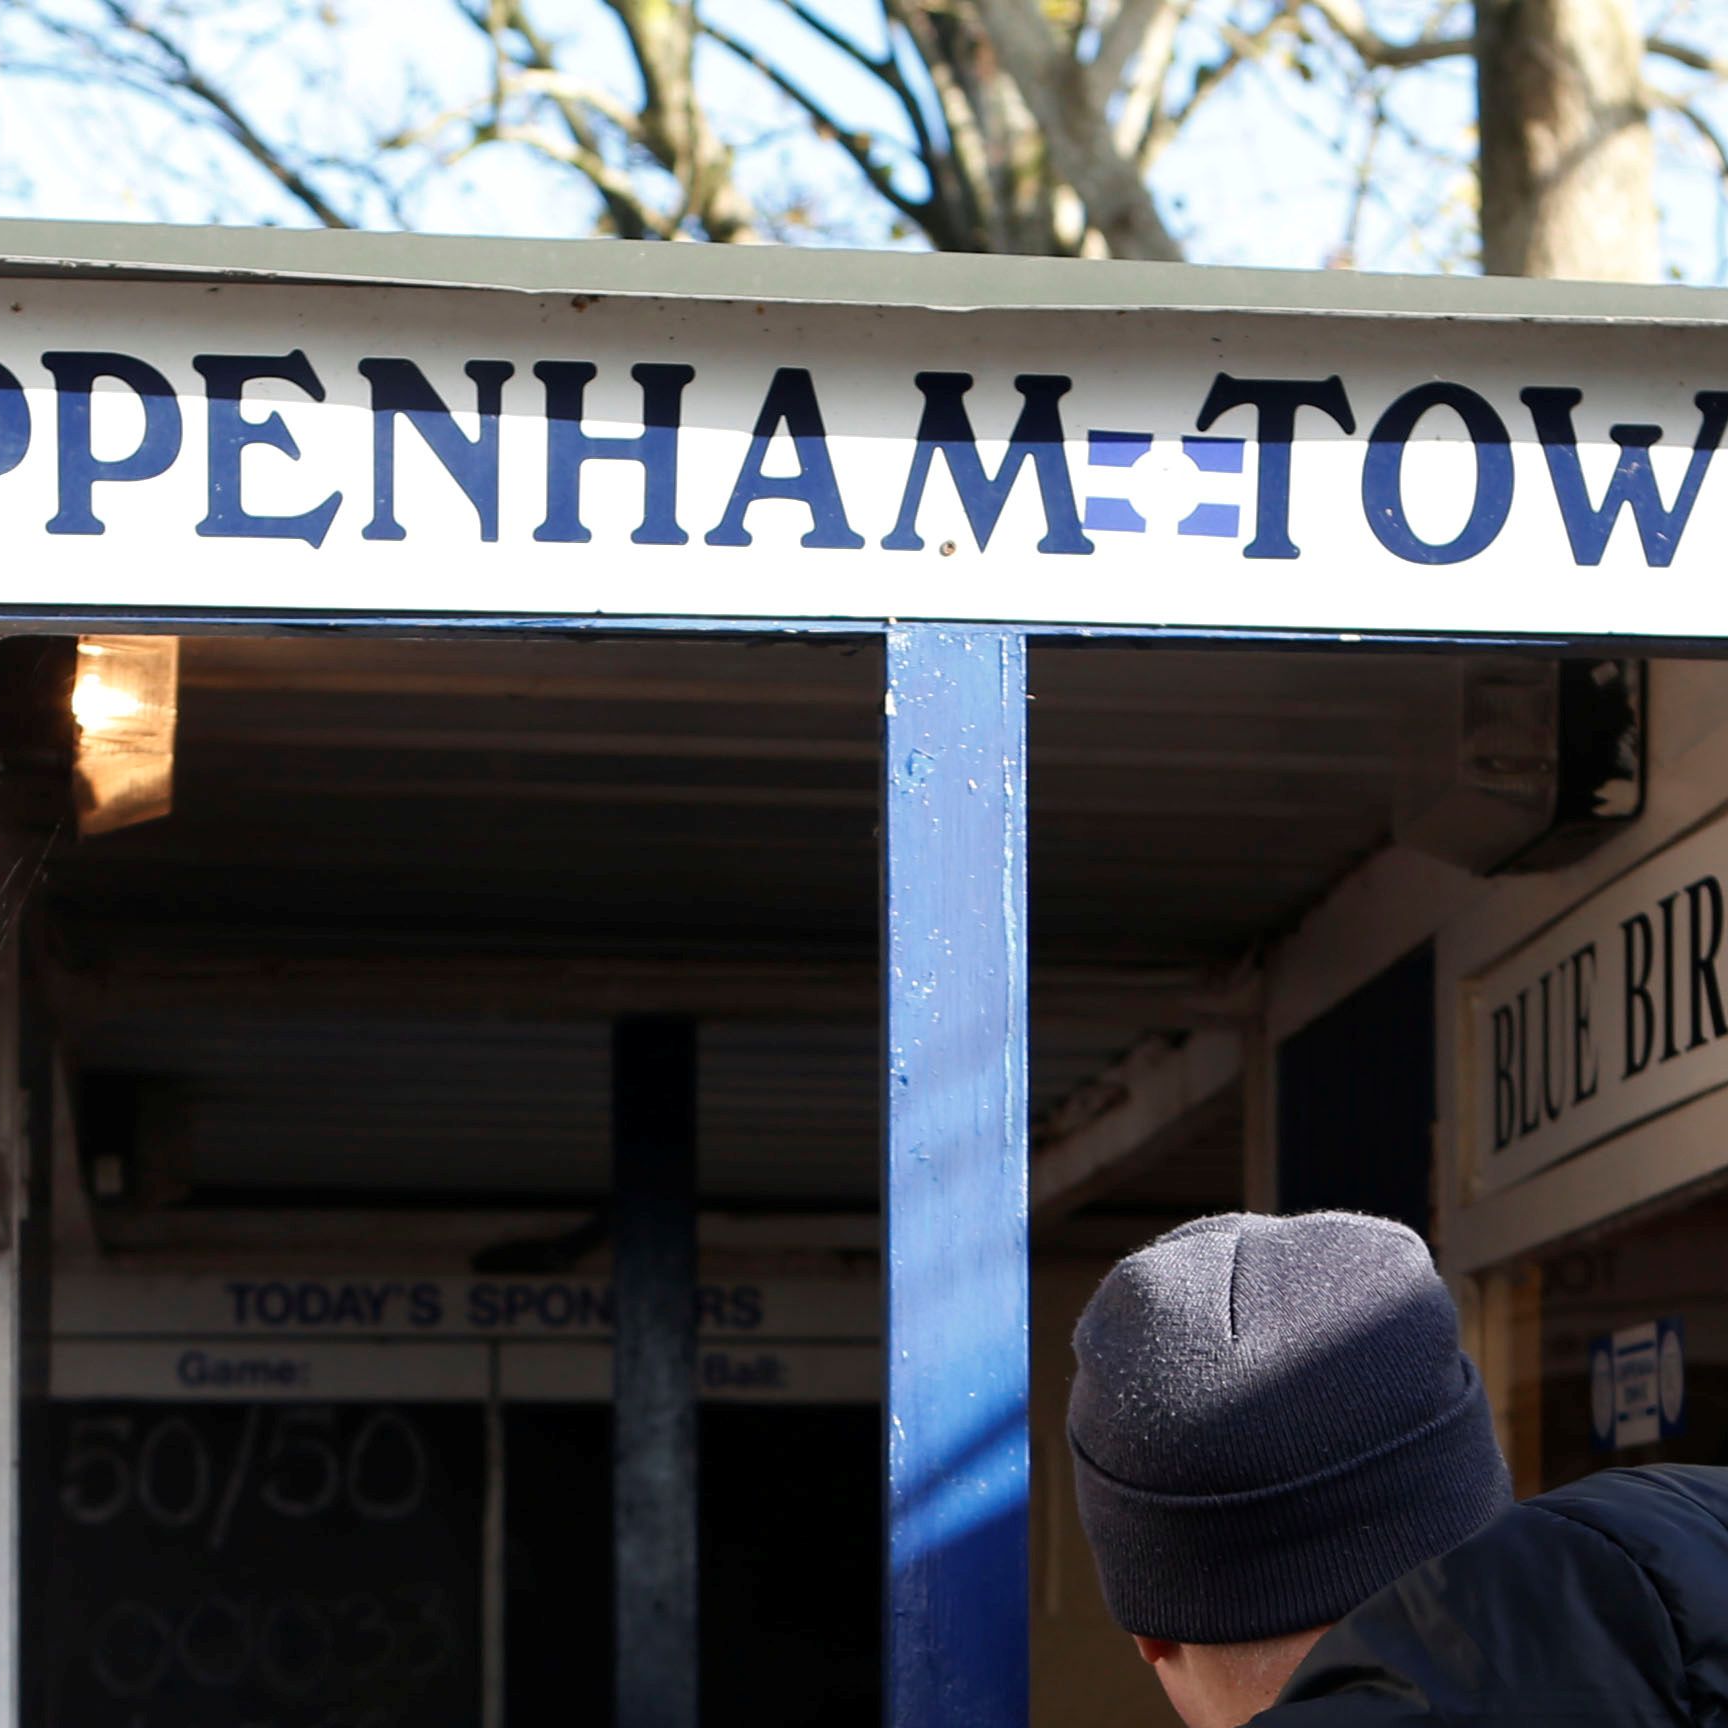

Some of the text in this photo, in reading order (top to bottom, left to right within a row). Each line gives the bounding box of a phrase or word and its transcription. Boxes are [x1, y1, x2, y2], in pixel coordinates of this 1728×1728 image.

[1491, 942, 1599, 1155] BLUE
[227, 1282, 764, 1329] TODAY'S SPONRS
[176, 1351, 310, 1387] Game:
[61, 1404, 427, 1548] 50/50
